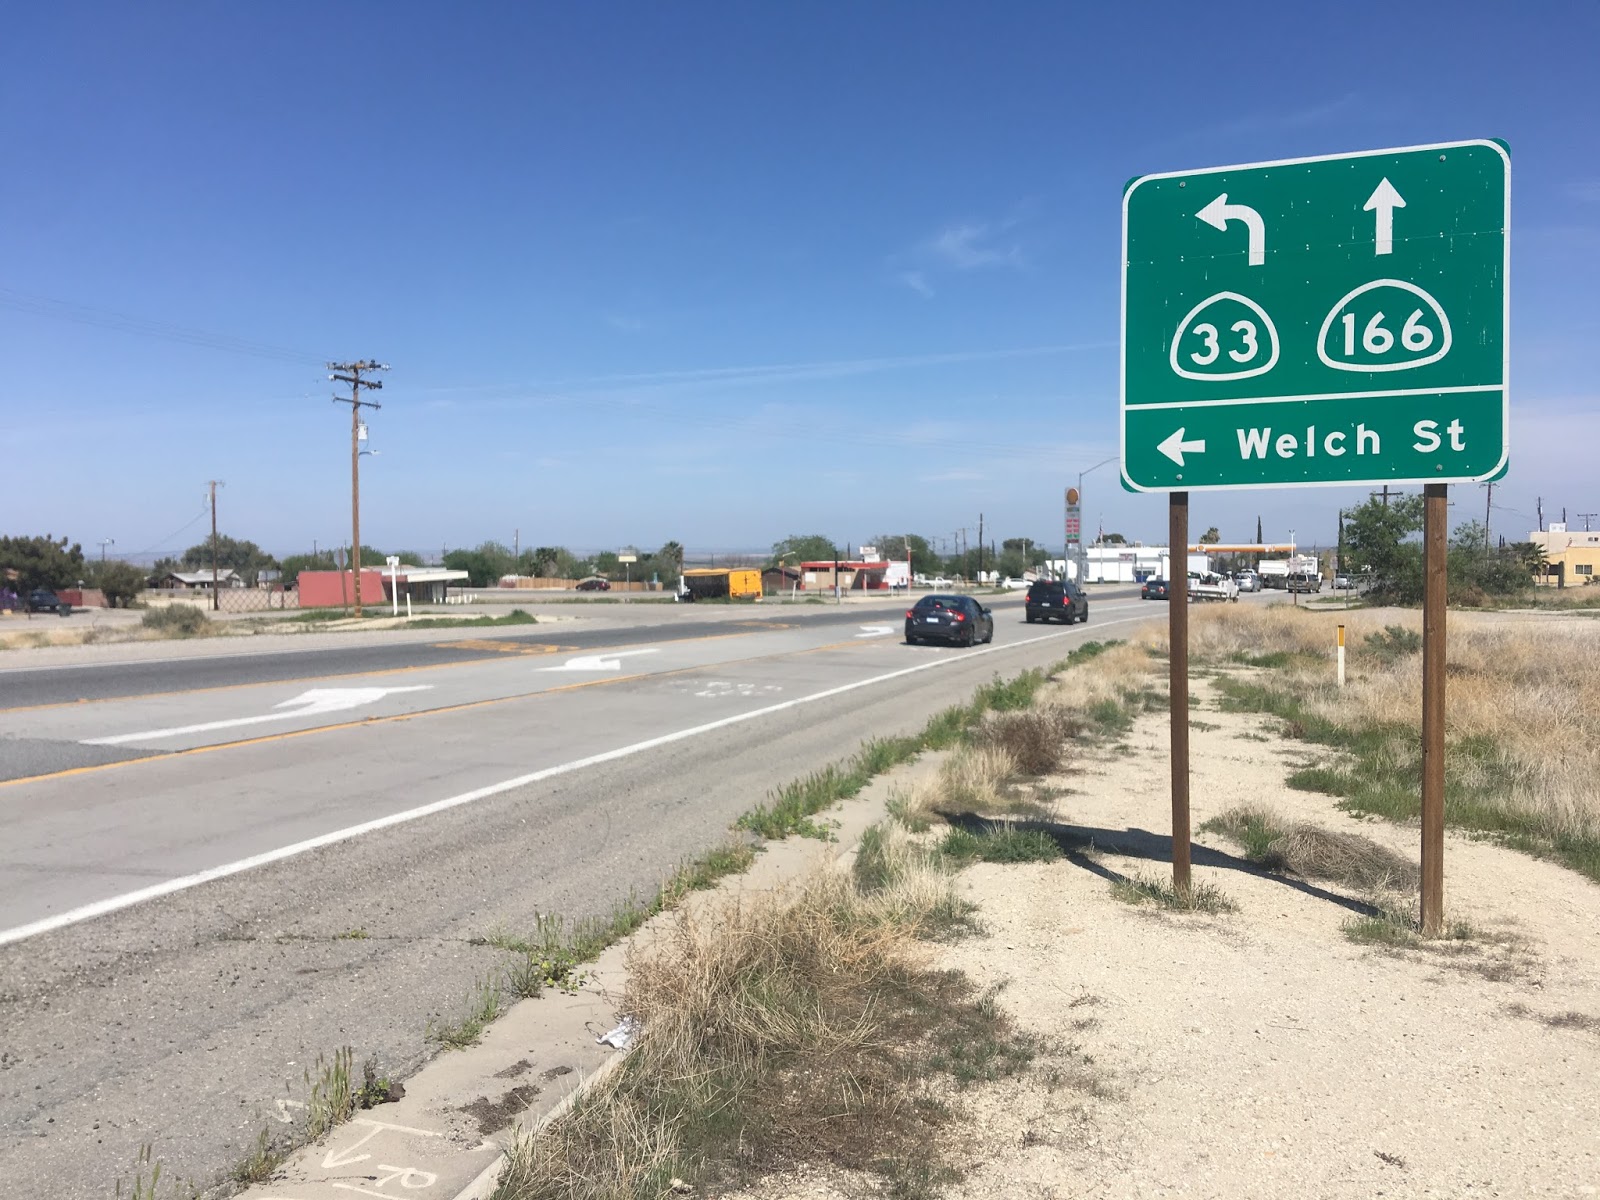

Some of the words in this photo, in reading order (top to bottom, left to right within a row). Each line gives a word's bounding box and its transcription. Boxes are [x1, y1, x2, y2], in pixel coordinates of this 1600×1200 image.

[1190, 320, 1258, 366] 33
[1342, 308, 1434, 356] 166
[1236, 423, 1381, 460] Welch
[1412, 418, 1466, 453] St
